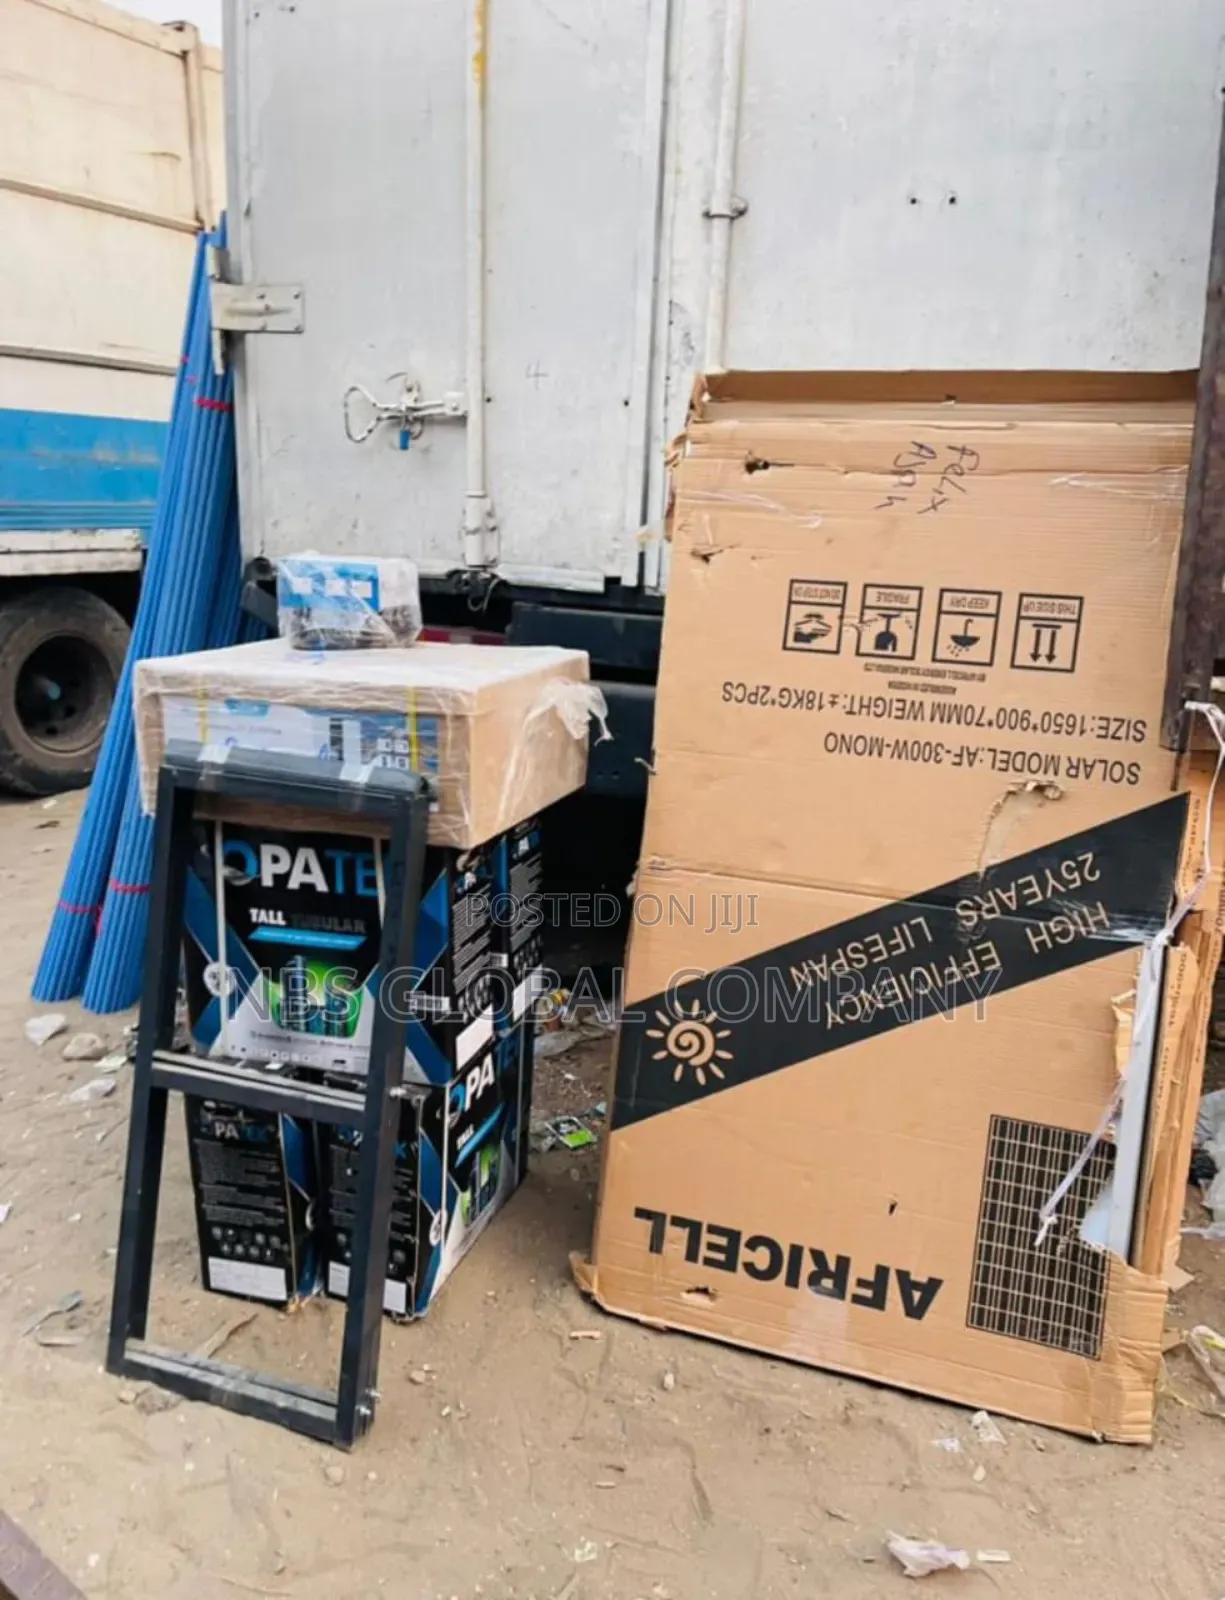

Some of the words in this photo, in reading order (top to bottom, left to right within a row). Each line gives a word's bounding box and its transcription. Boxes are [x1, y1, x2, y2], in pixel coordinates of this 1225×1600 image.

[876, 591, 910, 604] FRAGILE
[949, 596, 967, 608] DRY
[968, 597, 990, 609] KEEP
[1066, 754, 1141, 785] SOLAR
[248, 908, 287, 926] TALL
[1024, 901, 1111, 954] HIGH
[789, 915, 934, 992] LIFESPAN
[825, 940, 1002, 1030] EFFICIENCY
[633, 1207, 945, 1321] AFRICELL
